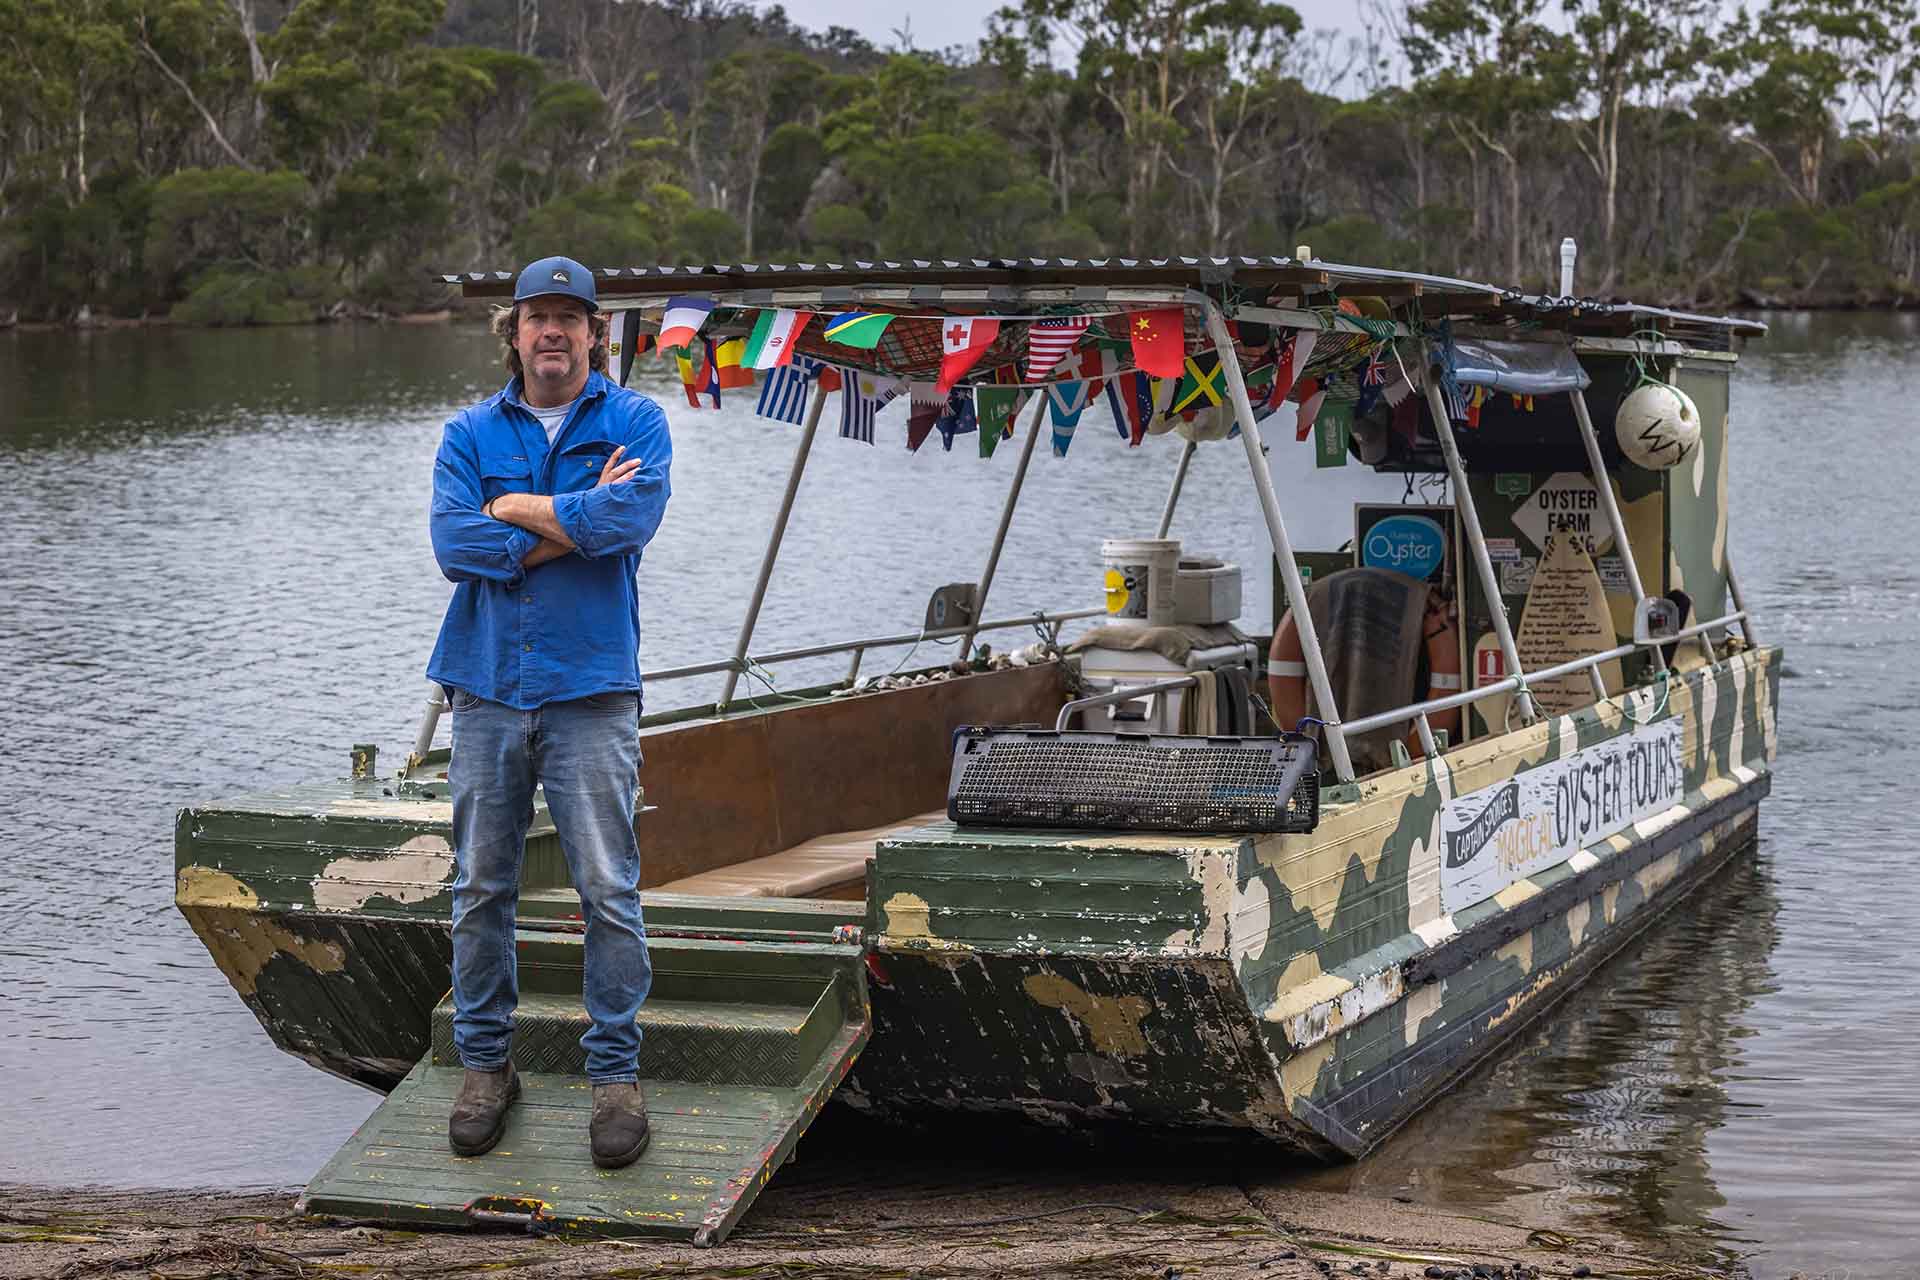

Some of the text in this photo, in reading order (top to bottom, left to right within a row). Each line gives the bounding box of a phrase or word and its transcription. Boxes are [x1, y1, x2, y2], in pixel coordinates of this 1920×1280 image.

[1539, 489, 1598, 511] OYSTER
[1369, 535, 1432, 566] Oyster
[1556, 753, 1622, 847] OYSTER
[1627, 732, 1677, 815] TOURS
[1456, 817, 1485, 861] CAPTAIN
